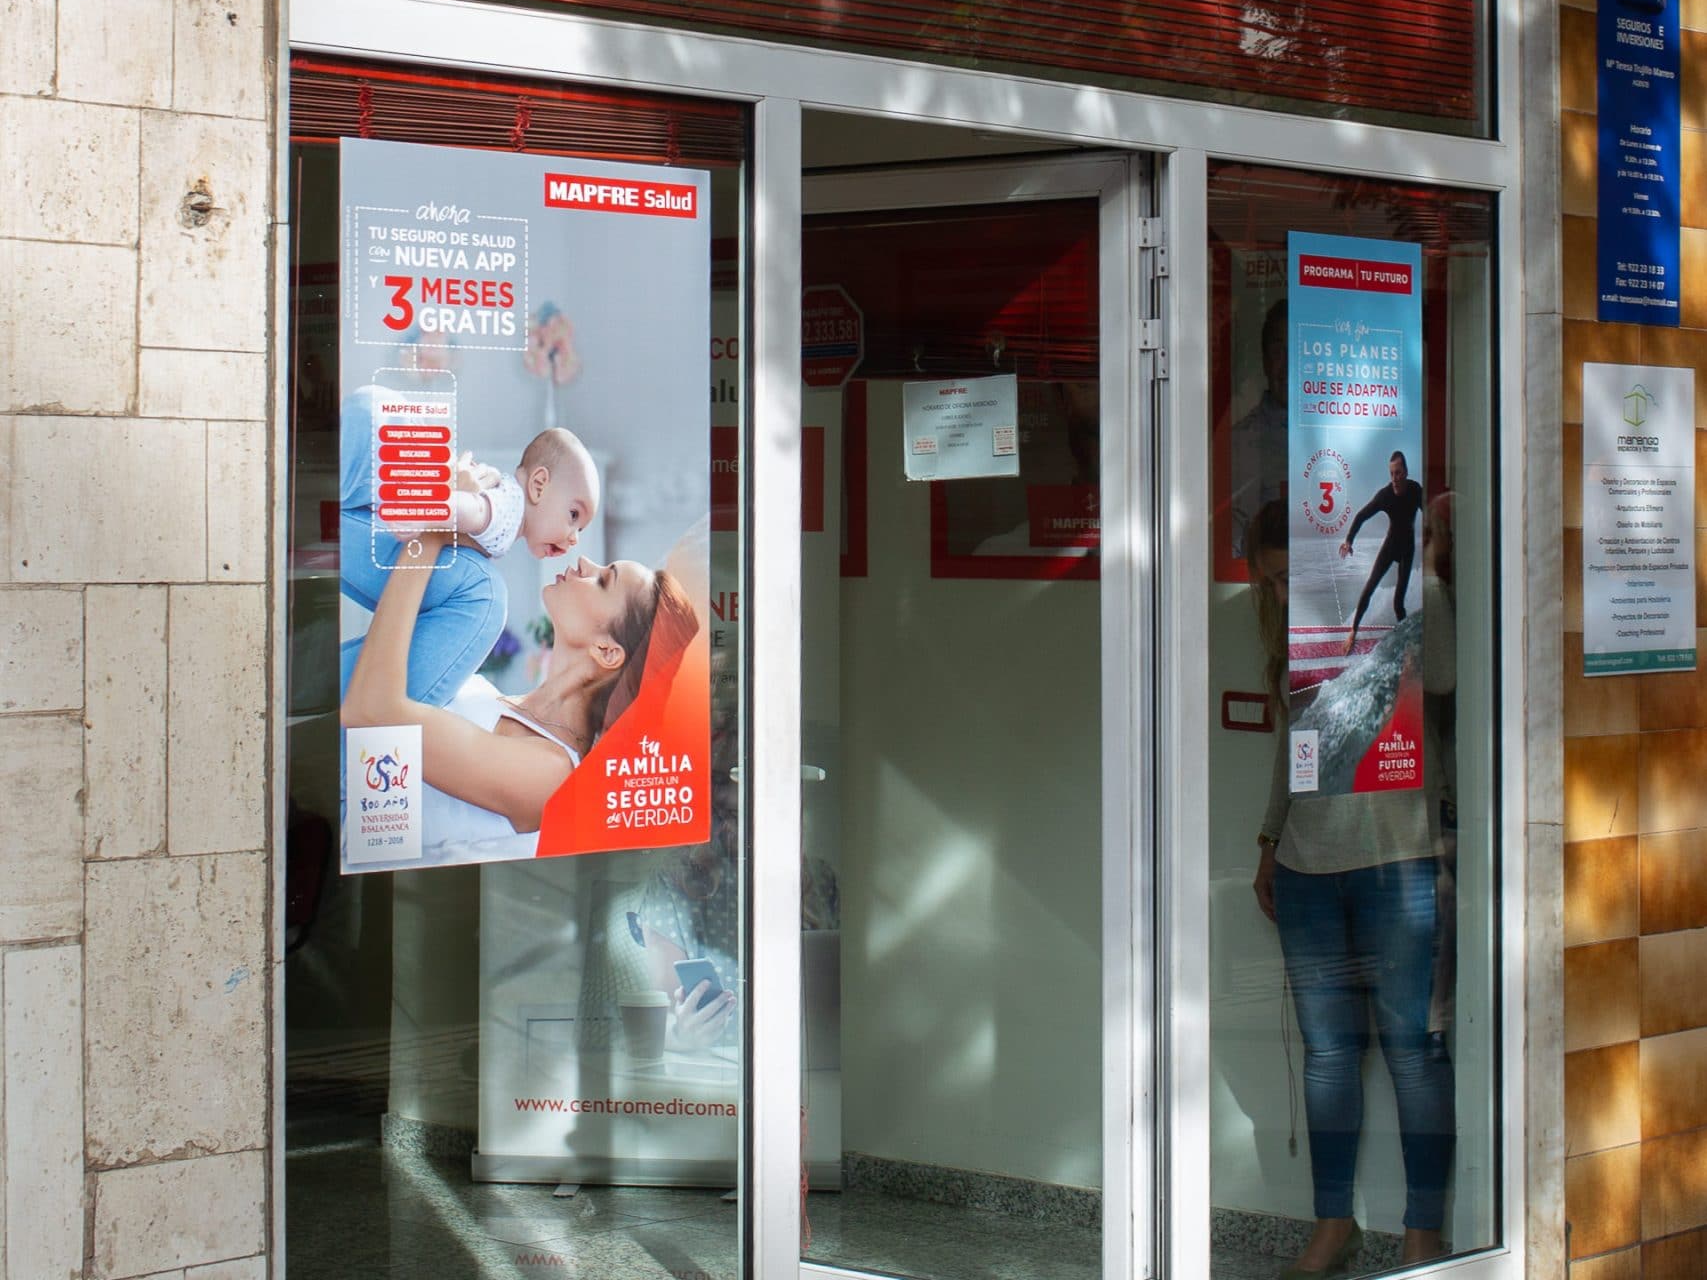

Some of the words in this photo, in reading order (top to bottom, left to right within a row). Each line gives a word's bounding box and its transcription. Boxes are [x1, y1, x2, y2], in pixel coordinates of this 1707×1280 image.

[1617, 18, 1651, 34] SEGUROS
[1659, 26, 1664, 37] E
[1617, 32, 1664, 50] INVERSIONES
[550, 181, 639, 206] MAPFRE
[644, 190, 692, 211] Salud
[416, 201, 470, 225] ahora
[368, 226, 387, 240] TU
[391, 231, 446, 245] SEGURO
[450, 234, 468, 246] DE
[472, 235, 516, 249] SALUD
[395, 246, 469, 270] NUEVA
[475, 251, 516, 272] APP
[1304, 265, 1353, 279] PROGRAMA
[1361, 270, 1372, 280] TU
[1374, 271, 1408, 284] FUTURO
[369, 276, 378, 288] Y
[383, 275, 414, 331] 3
[421, 277, 514, 308] MESES
[419, 307, 516, 336] GRATIS
[1304, 341, 1332, 356] LOS
[1340, 343, 1398, 360] PLANES
[1317, 363, 1398, 379] PENSIONES
[1303, 380, 1327, 394] QUE
[1330, 382, 1343, 395] SE
[1347, 383, 1398, 397] ADAPTAN
[382, 404, 422, 414] MAPFRE
[1318, 401, 1351, 415] CICLO
[1354, 403, 1369, 415] DE
[1372, 404, 1398, 417] VIDA
[639, 735, 660, 757] tu
[1379, 740, 1416, 752] FAMILIA
[606, 754, 692, 776] FAMILIA
[1379, 758, 1415, 770] FUTURO
[624, 777, 664, 788] NECESITA
[665, 776, 679, 785] UN
[1385, 769, 1416, 781] VERDAD
[607, 786, 693, 809] SEGURO
[622, 806, 693, 828] VERDAD
